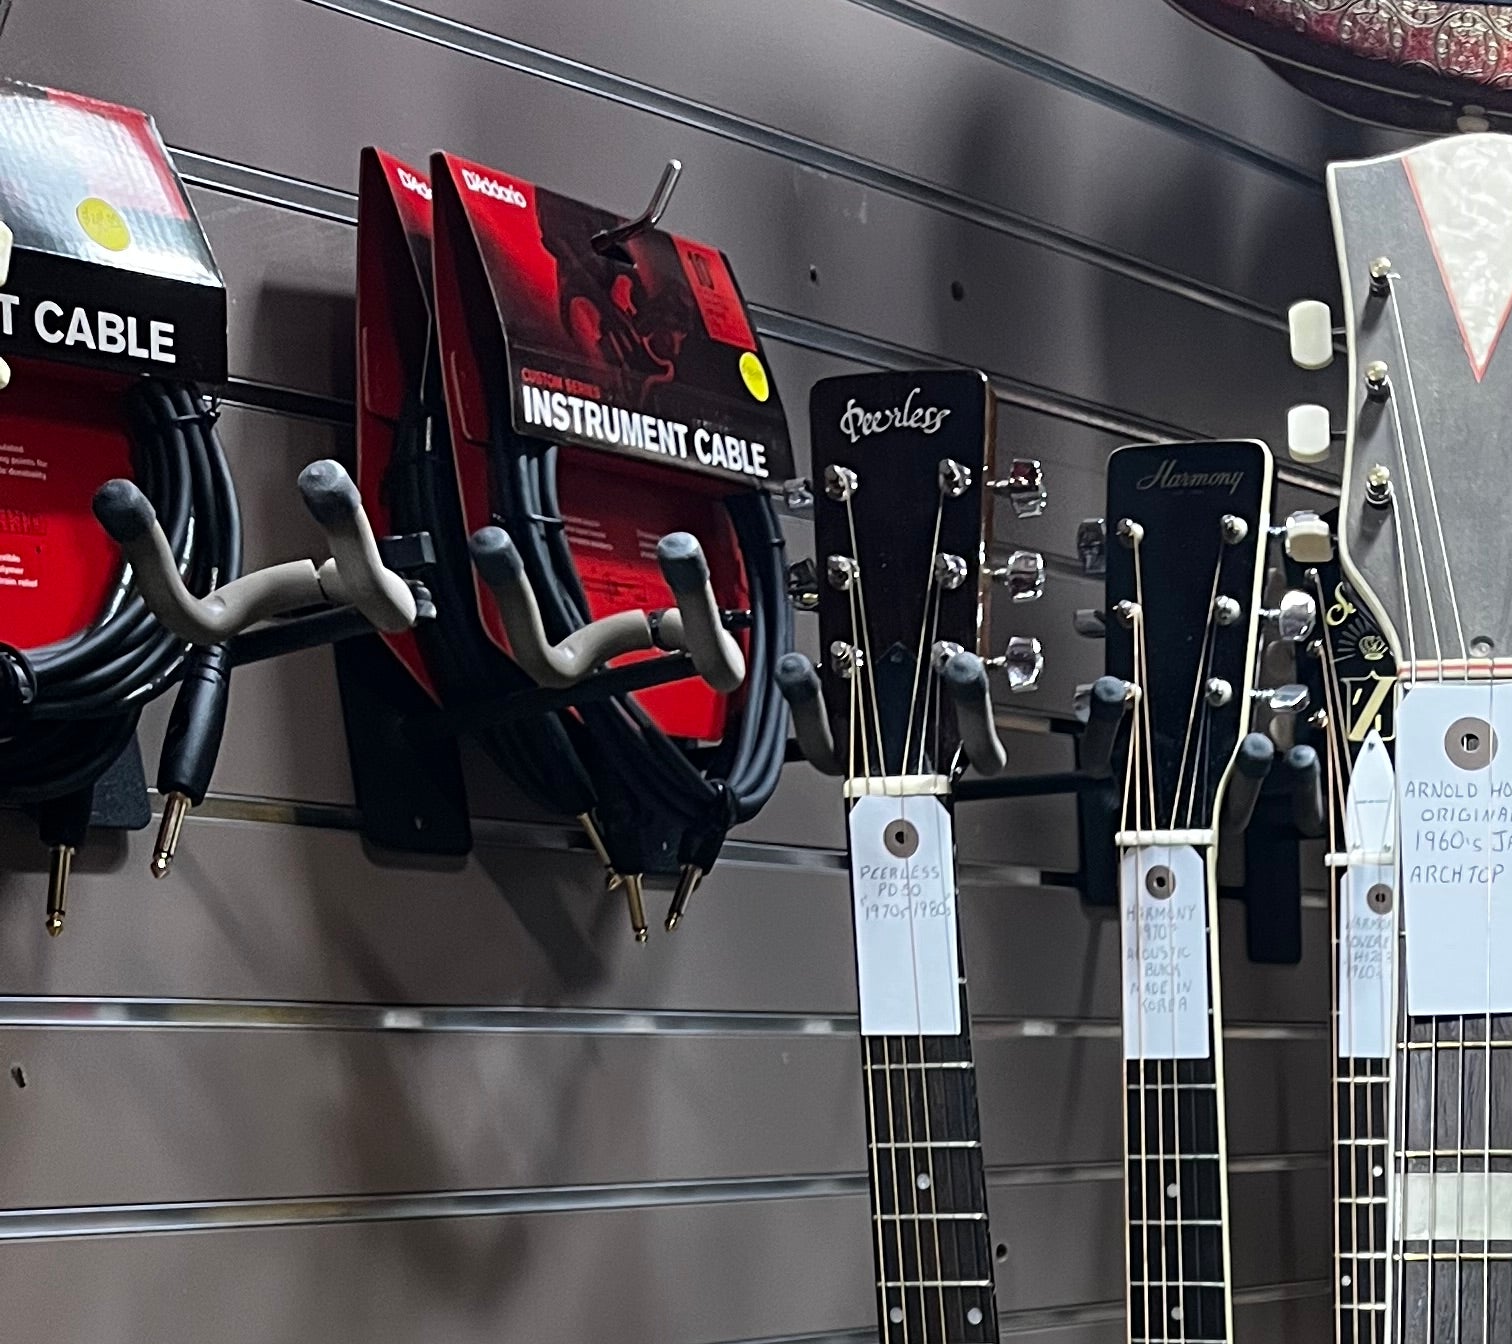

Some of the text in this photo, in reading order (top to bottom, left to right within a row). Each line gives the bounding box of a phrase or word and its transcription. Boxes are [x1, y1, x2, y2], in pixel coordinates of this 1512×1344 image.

[461, 168, 527, 208] D'Addario
[34, 300, 176, 363] CABLE
[521, 385, 769, 478] INSTRUMENT CABLE
[840, 387, 951, 443] Peerless
[1136, 459, 1244, 495] Harmony
[1404, 780, 1478, 799] ARNOLD
[860, 864, 940, 880] PEERLESS
[1127, 946, 1192, 961] AOUSTIC
